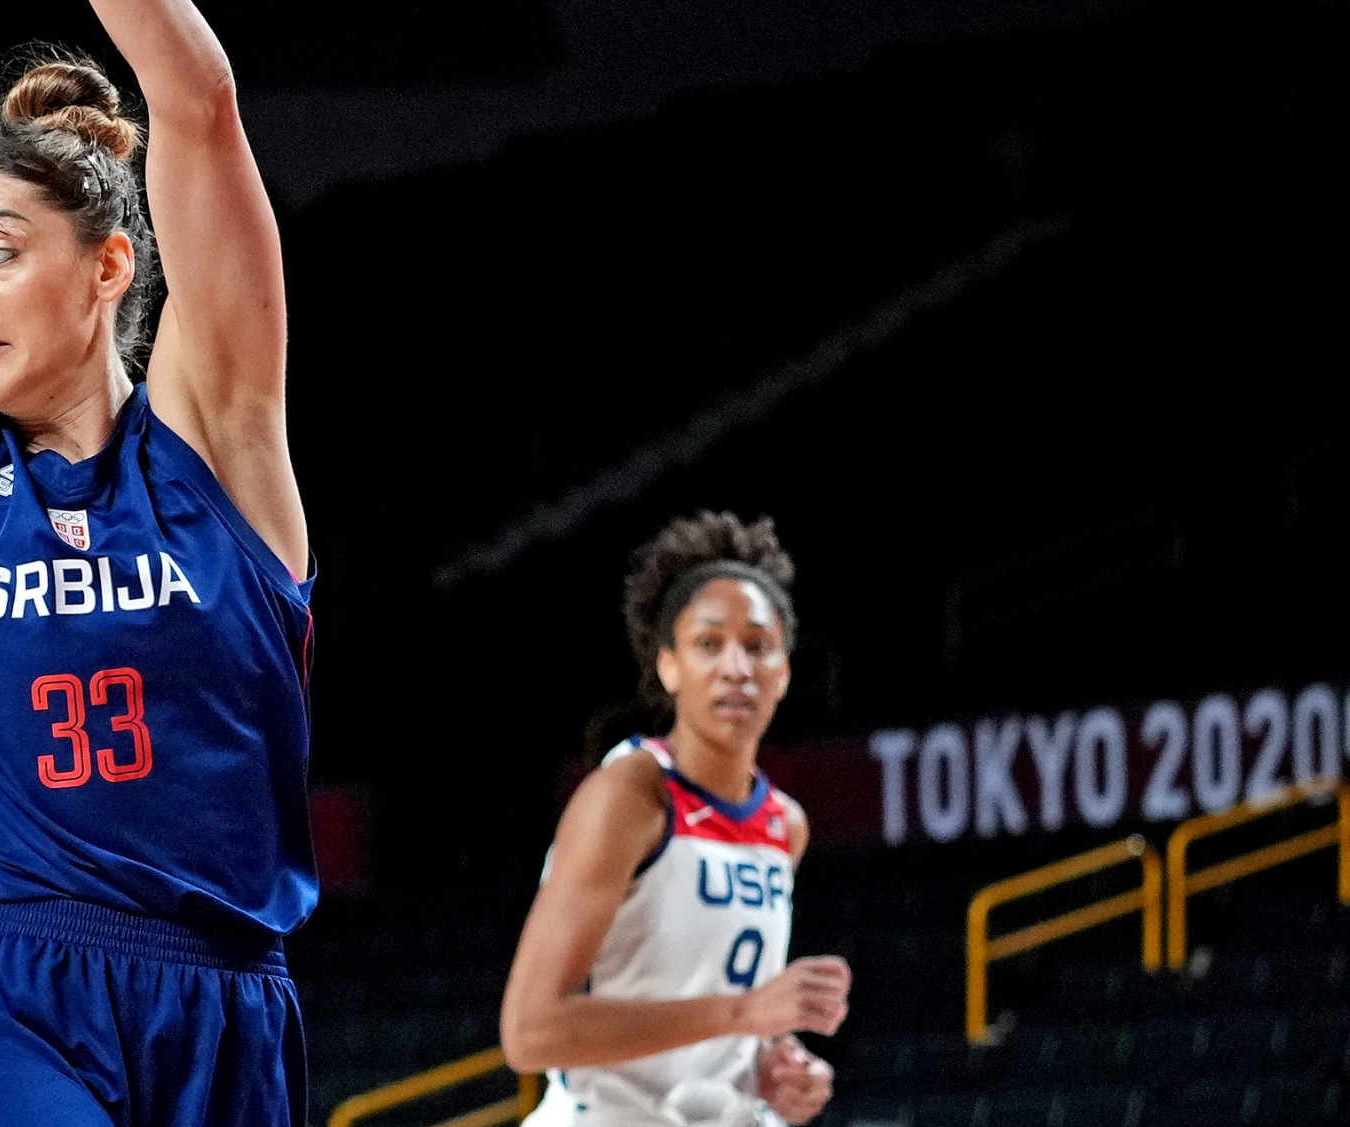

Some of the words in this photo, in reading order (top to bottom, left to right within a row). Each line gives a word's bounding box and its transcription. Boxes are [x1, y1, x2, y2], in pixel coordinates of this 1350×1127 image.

[31, 667, 153, 789] 33
[871, 704, 1129, 845] TOKYO
[1142, 682, 1342, 824] 2020
